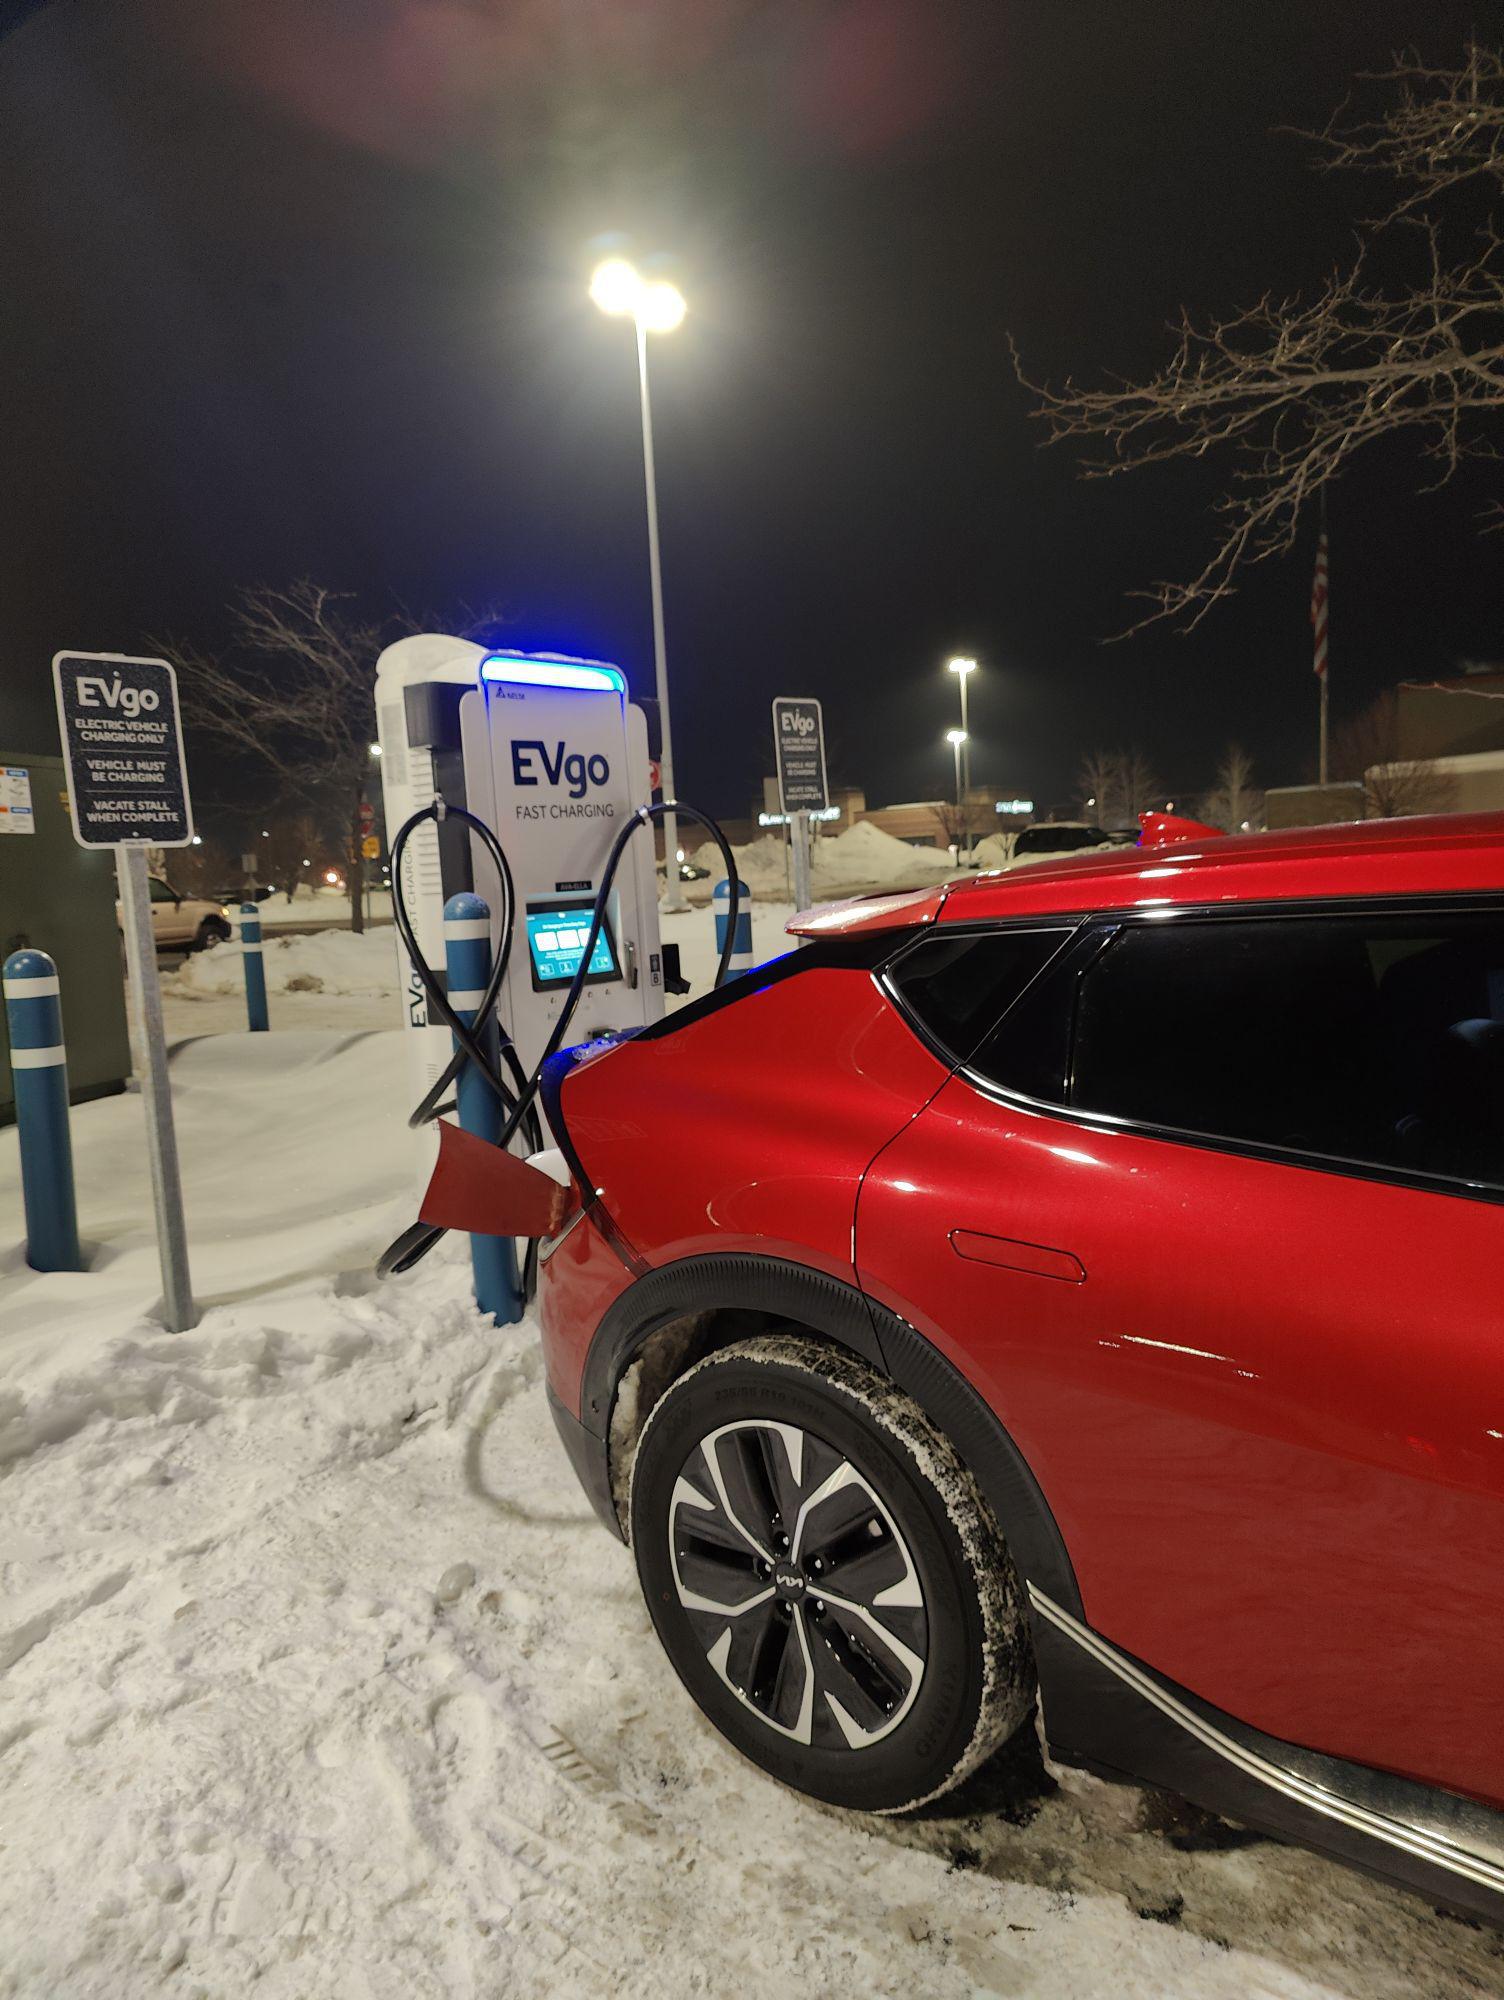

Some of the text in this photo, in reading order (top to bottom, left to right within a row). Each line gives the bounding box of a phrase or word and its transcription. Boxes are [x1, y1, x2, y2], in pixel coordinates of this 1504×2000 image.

[76, 677, 160, 717] EVgo
[75, 718, 169, 733] ELECTRIC VEHICLE
[781, 712, 815, 736] EVgo
[81, 731, 165, 744] CHARGING ONLY
[87, 760, 167, 771] VEHICLE MUST
[511, 740, 609, 799] EVgo
[92, 771, 165, 783] BE CHARGING
[93, 801, 170, 811] VACATE STALL
[516, 803, 615, 820] FAST CHARGING
[86, 812, 179, 823] WHEN COMPLETE
